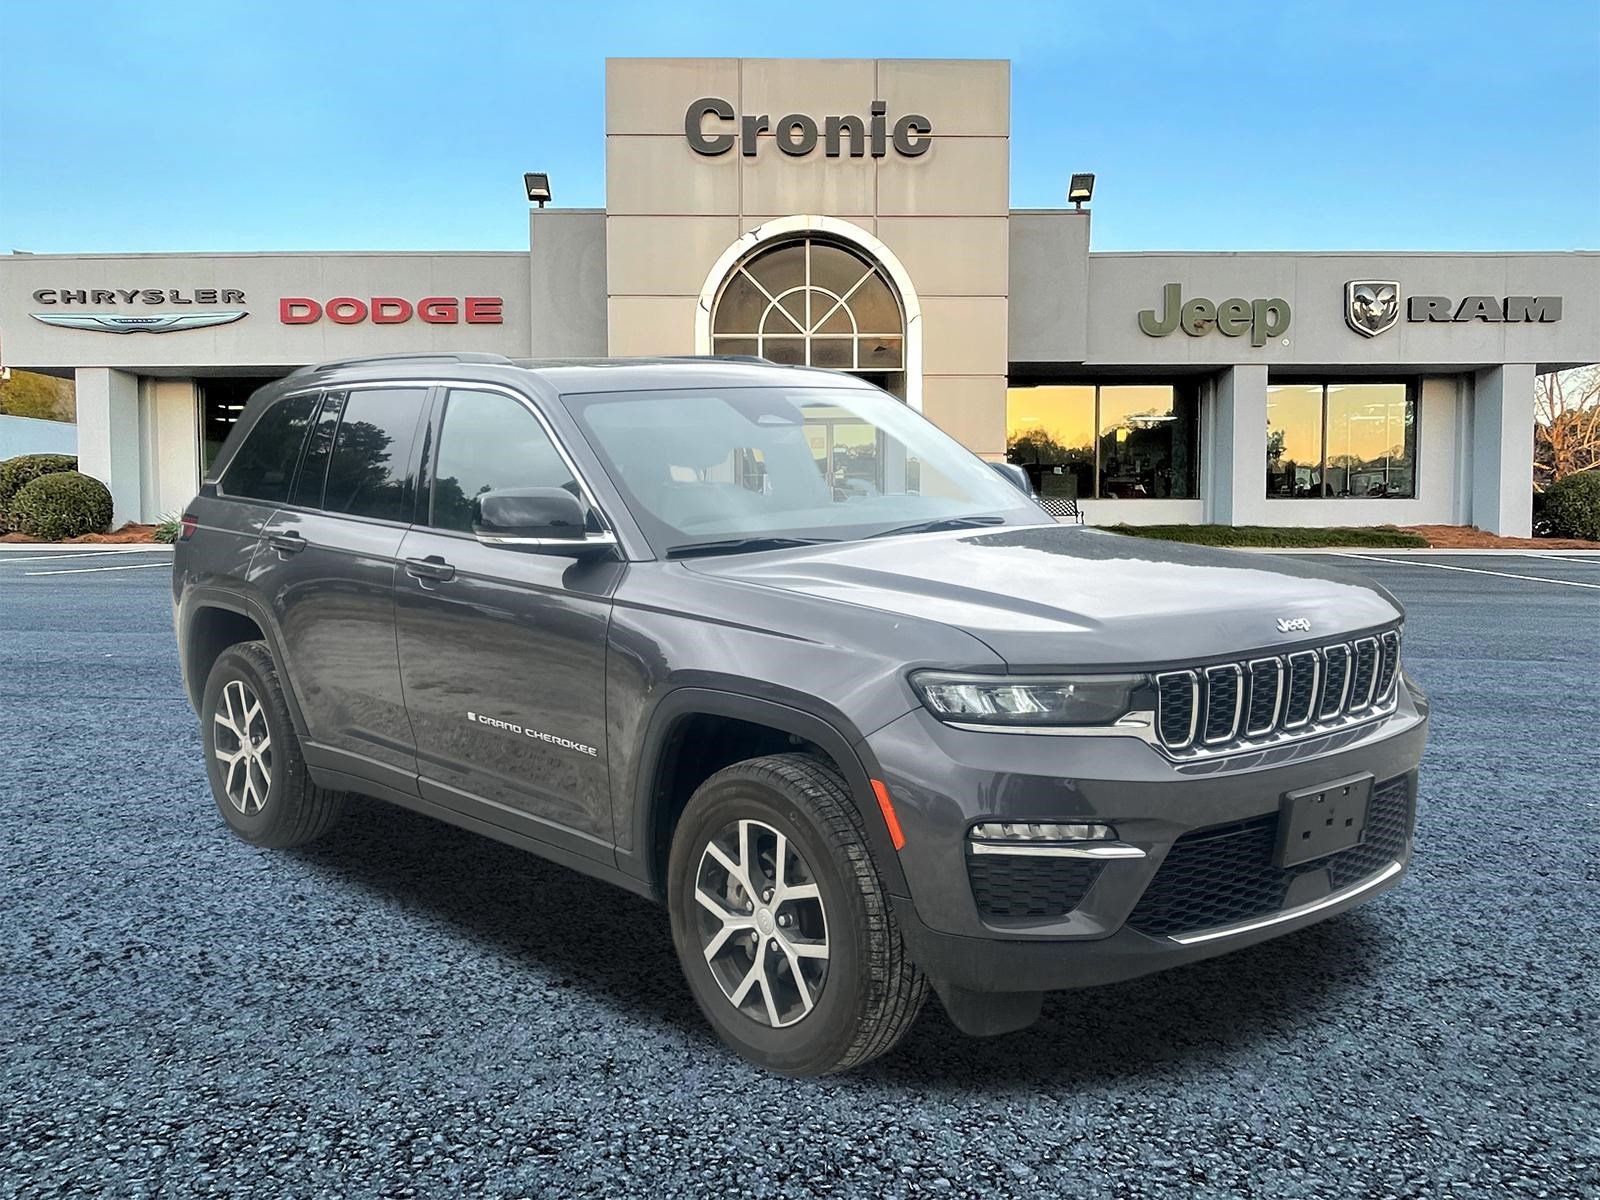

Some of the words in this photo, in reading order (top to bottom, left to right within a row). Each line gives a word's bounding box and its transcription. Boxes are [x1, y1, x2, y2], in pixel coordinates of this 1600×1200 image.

[685, 97, 932, 158] Cronic
[32, 289, 246, 305] CHRYSLER
[279, 297, 504, 325] DODGE
[1407, 296, 1563, 323] RAM
[1138, 283, 1291, 347] Jeep
[1276, 617, 1311, 633] Jeep
[478, 715, 522, 734] GRAND
[525, 728, 598, 757] CHEROKEE
